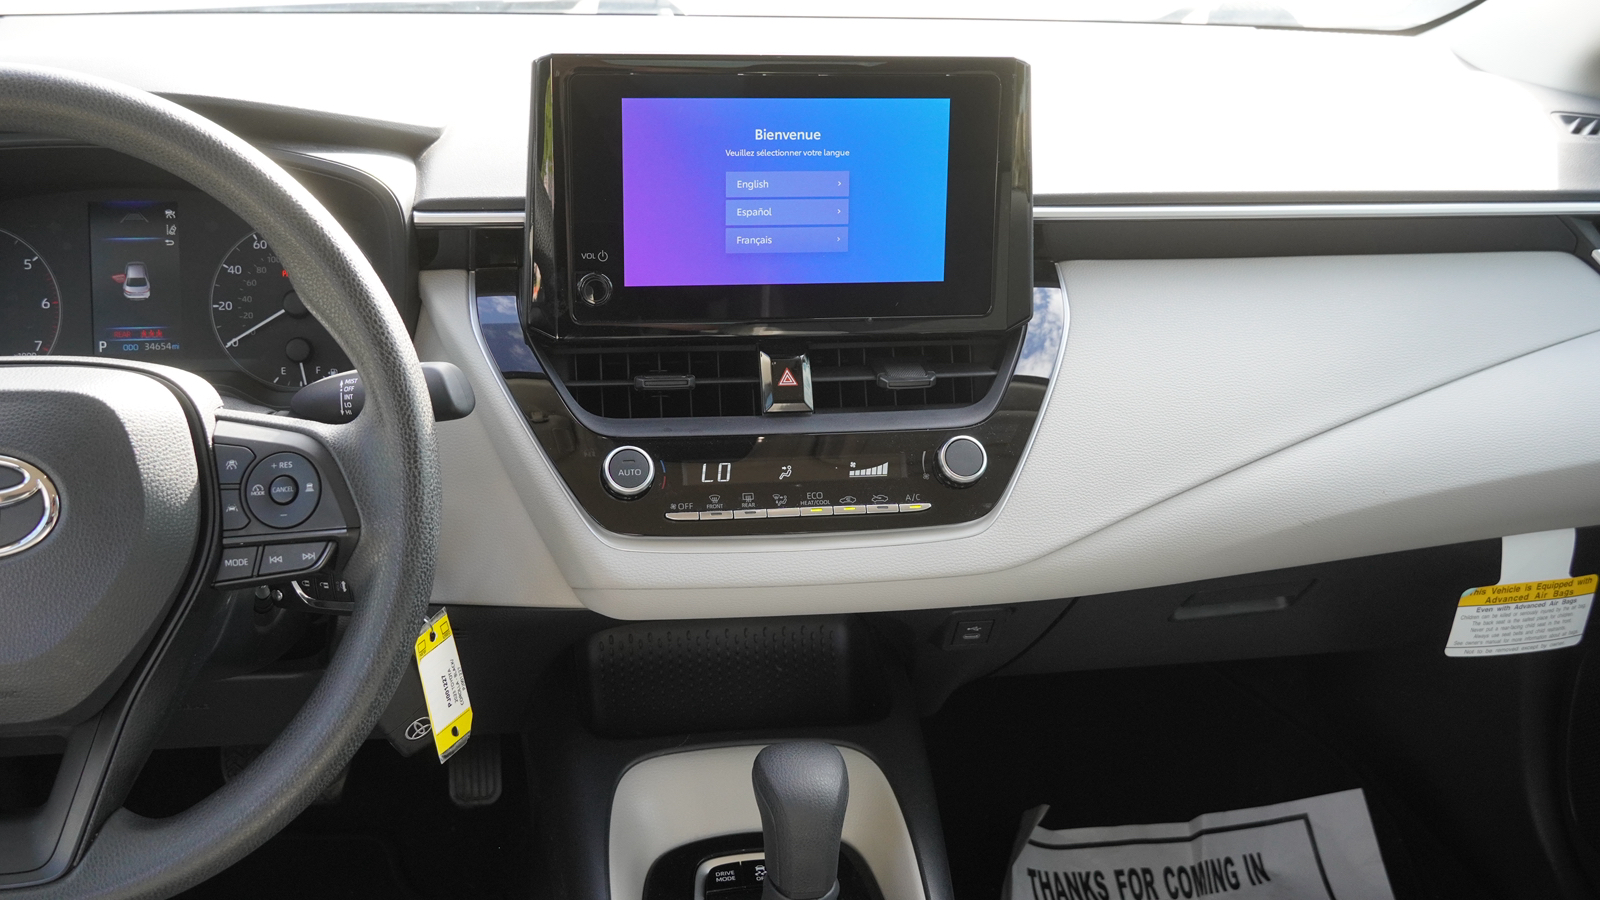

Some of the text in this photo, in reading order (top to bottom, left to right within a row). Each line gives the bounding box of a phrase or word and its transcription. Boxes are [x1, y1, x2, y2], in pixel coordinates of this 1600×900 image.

[755, 129, 821, 140] Bienvenue
[725, 148, 850, 158] Veuillez sélectionner votre langue
[737, 180, 769, 190] English
[737, 208, 772, 217] Español
[253, 240, 267, 249] 60
[737, 236, 772, 246] Français
[24, 259, 32, 270] 5
[227, 265, 242, 274] 40
[41, 298, 51, 309] 6
[218, 301, 233, 311] 20
[34, 340, 43, 351] 7
[99, 341, 107, 352] P
[281, 367, 287, 375] E
[279, 461, 293, 469] RES
[806, 492, 824, 500] ECO
[225, 558, 249, 567] MODE
[1492, 586, 1521, 594] Vehicle
[1536, 580, 1574, 591] Equipped
[1578, 577, 1593, 586] with
[1485, 593, 1530, 604] Advanced
[1514, 601, 1546, 610] Advanced
[1027, 852, 1271, 900] THANKS FOR COMING IN
